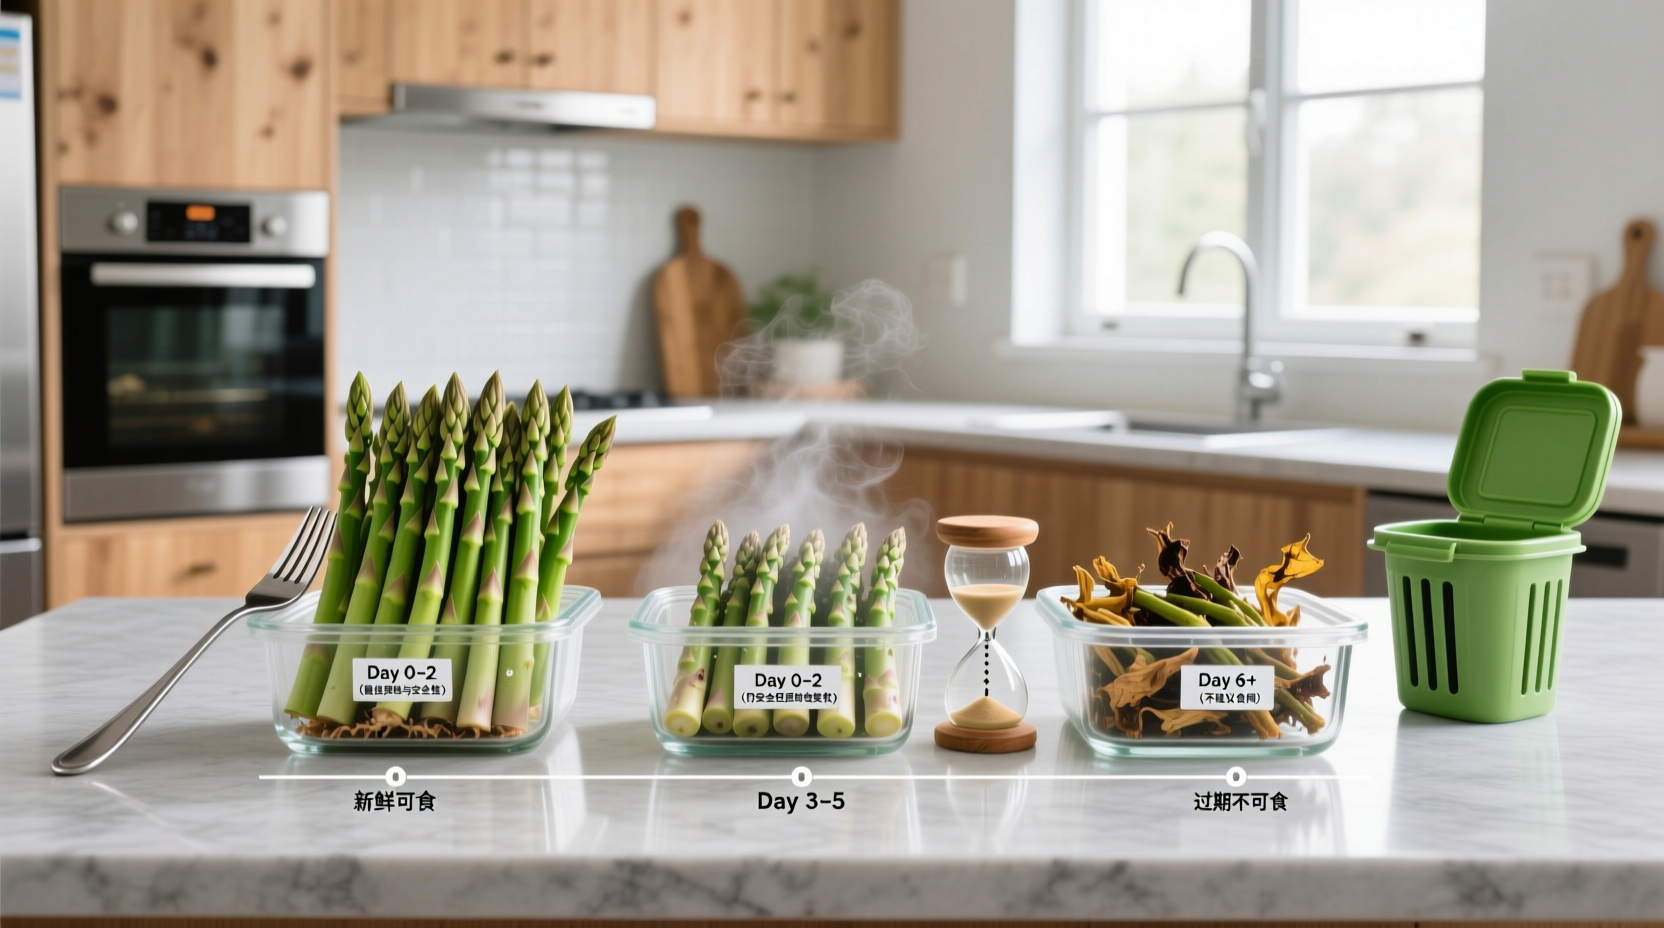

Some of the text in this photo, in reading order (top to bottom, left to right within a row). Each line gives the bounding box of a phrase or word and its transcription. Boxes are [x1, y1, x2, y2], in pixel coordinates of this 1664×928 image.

[367, 665, 400, 684] Day
[755, 673, 786, 690] Day
[1198, 672, 1257, 691] Day 6+
